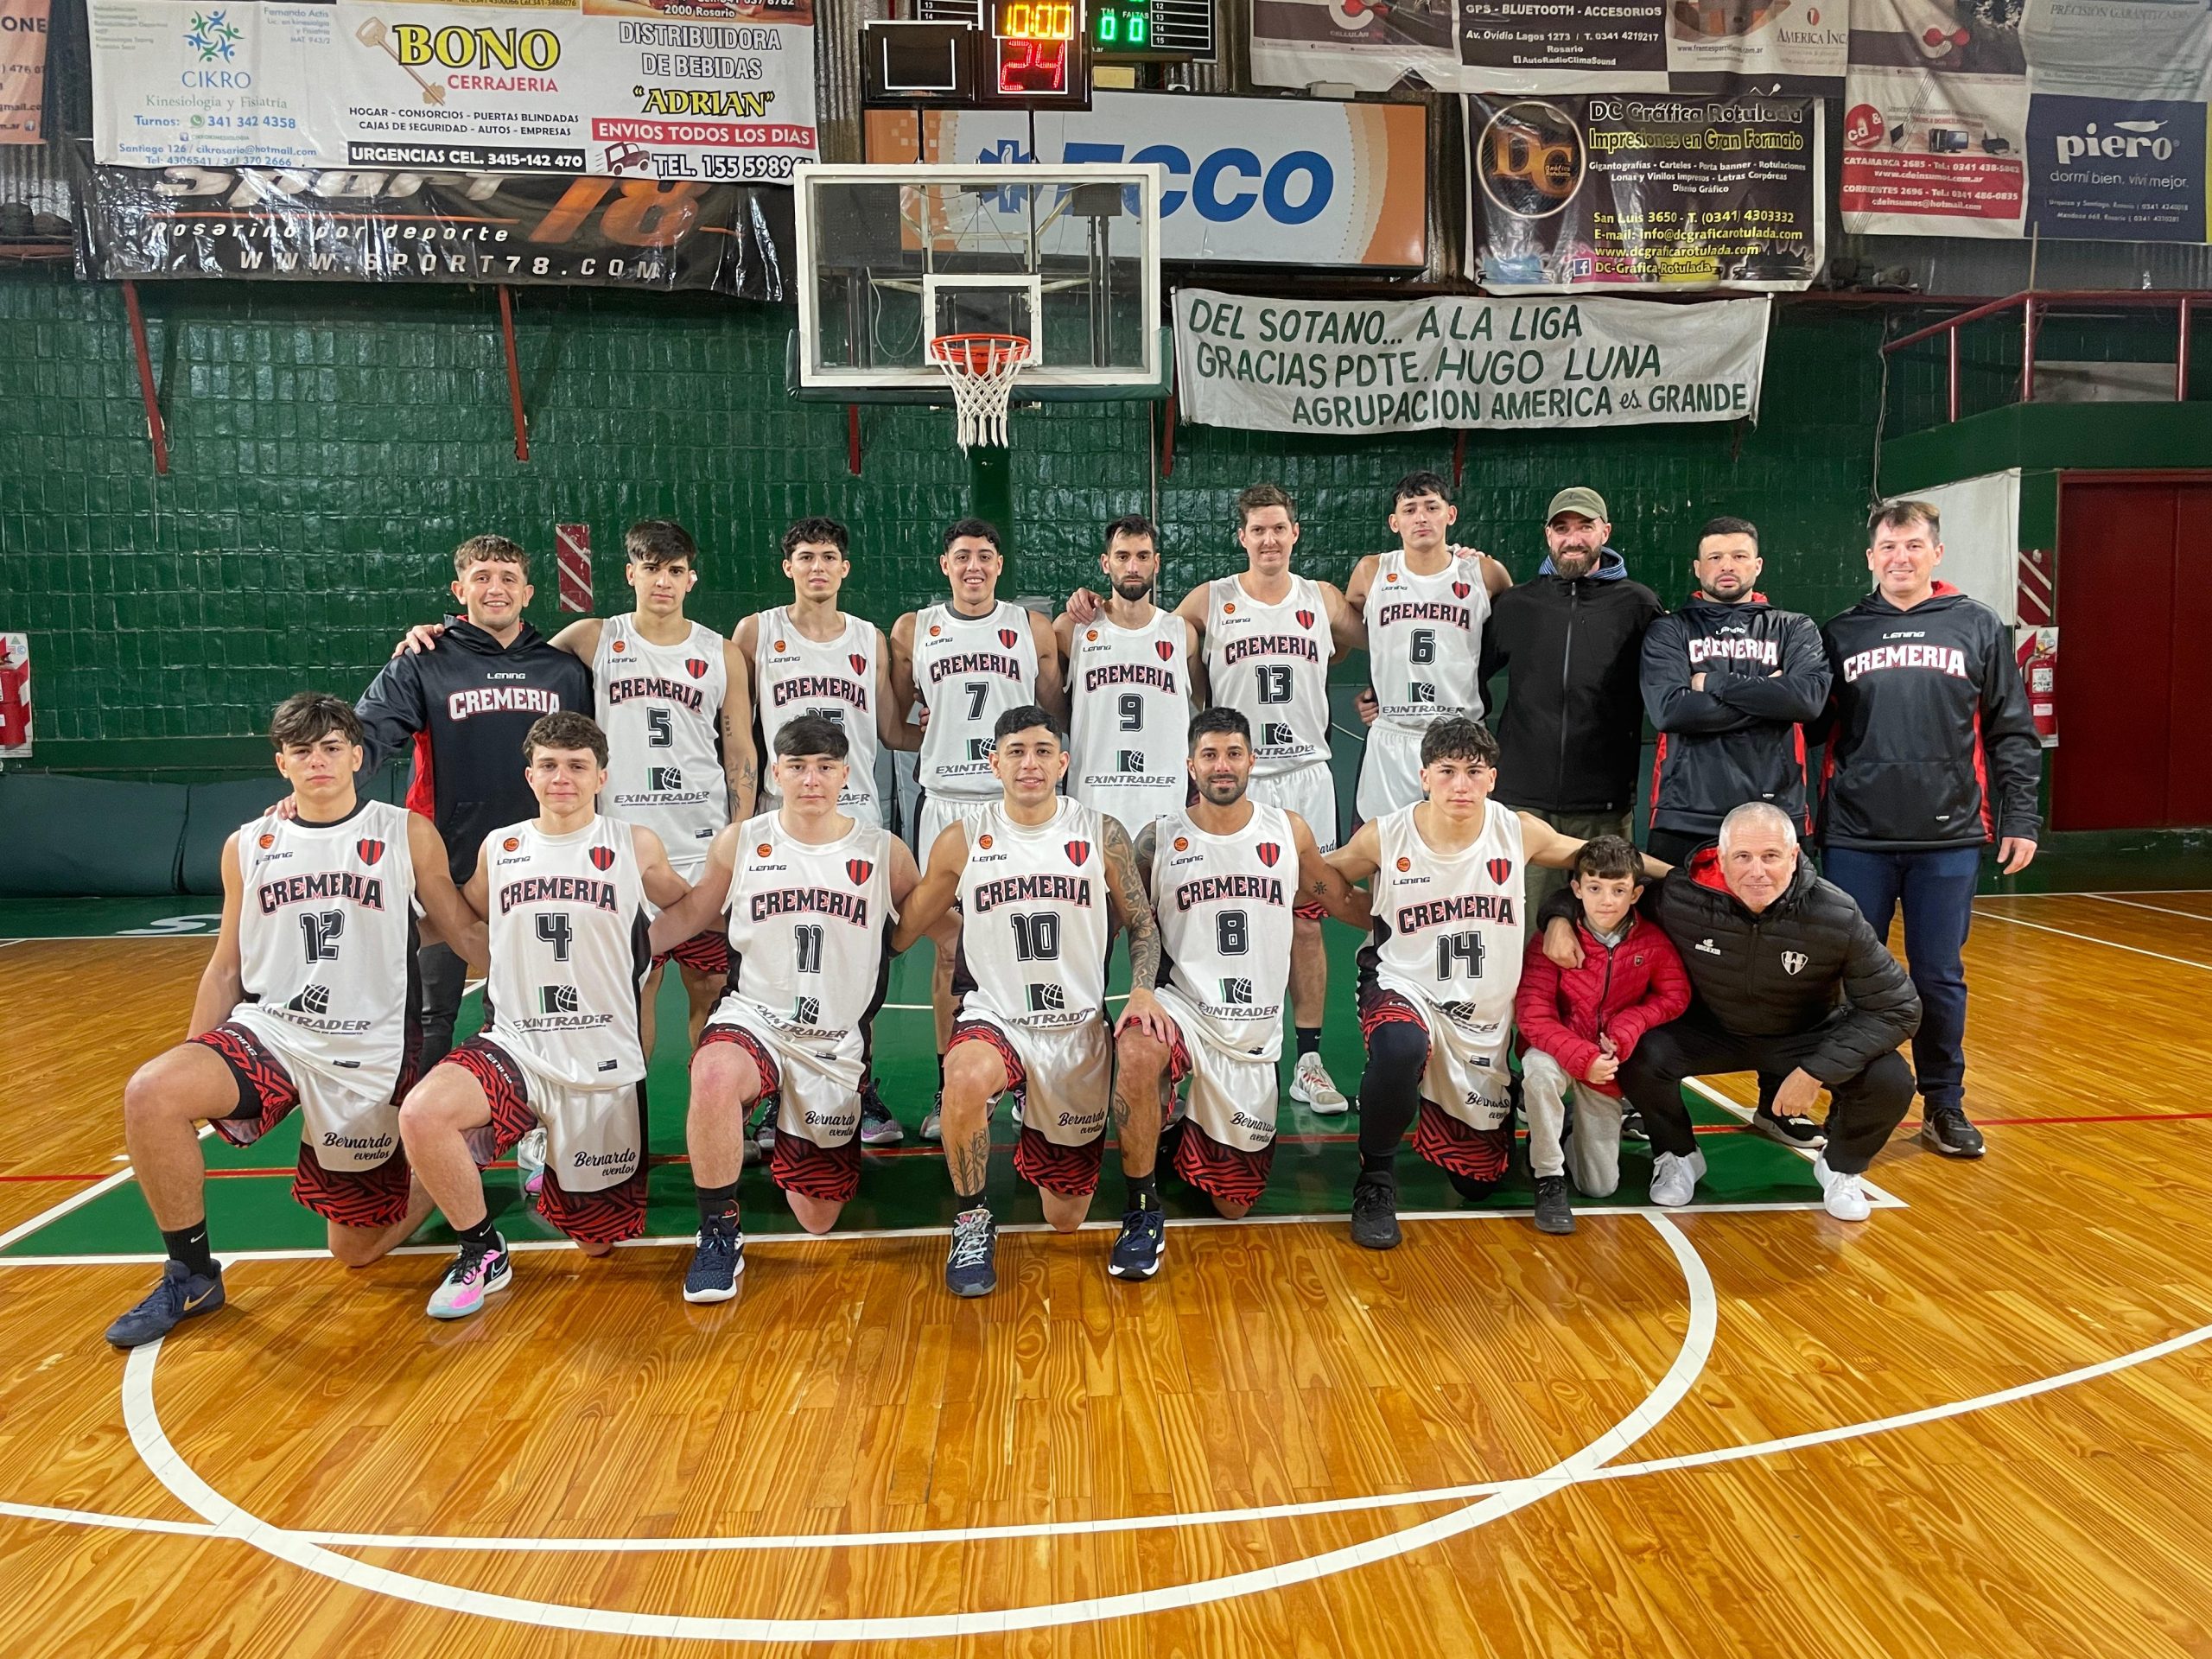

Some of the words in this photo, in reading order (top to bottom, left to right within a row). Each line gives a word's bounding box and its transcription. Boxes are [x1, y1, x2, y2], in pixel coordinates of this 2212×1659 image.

[664, 5, 693, 16] 2000
[696, 7, 734, 18] Rosario
[1007, 4, 1071, 37] 10:00
[1466, 5, 1491, 14] GPS
[1503, 6, 1574, 16] BLUETOOTH
[1584, 6, 1662, 16] ACCESORIOS
[620, 22, 782, 50] DISTRIBUIDORA
[1101, 16, 1115, 41] 0
[1128, 19, 1144, 41] 0
[1466, 30, 1482, 40] Av.
[1484, 31, 1513, 40] Ovidio
[1516, 32, 1544, 41] Lagos
[1548, 32, 1570, 41] 1273
[1621, 32, 1658, 41] 4219217
[392, 24, 561, 71] BONO
[1522, 56, 1616, 66] AutoRadioClimaSound
[642, 53, 671, 76] DE
[675, 55, 762, 79] BEBIDAS
[1001, 40, 1065, 91] 24
[182, 71, 251, 88] CIKRO
[448, 74, 558, 92] CERRAJERIA
[228, 99, 234, 111] y
[349, 107, 388, 117] HOGAR
[398, 109, 463, 119] CONSORCIOS
[474, 112, 518, 121] PUERTAS
[521, 113, 579, 123] BLINDADAS
[1590, 101, 1624, 121] DC
[1627, 102, 1703, 122] Gráfica
[1707, 104, 1802, 123] Rotulada
[134, 116, 180, 125] Turnos:
[208, 117, 230, 127] 341
[237, 117, 258, 127] 342
[263, 117, 295, 128] 4358
[359, 121, 389, 130] CAJAS
[410, 123, 467, 133] SEGURIDAD
[478, 125, 510, 135] AUTOS
[520, 126, 570, 136] EMPRESAS
[599, 123, 664, 140] ENVIOS
[668, 126, 729, 142] TODOS
[734, 129, 766, 143] LOS
[771, 130, 810, 145] DIAS
[119, 143, 164, 154] Santiago
[168, 144, 186, 153] 126
[196, 145, 316, 156] cikrosario@hotmail.com
[1590, 128, 1680, 154] Impresiones
[1683, 135, 1702, 149] en
[1705, 129, 1741, 150] Gran
[1745, 129, 1803, 150] Formato
[2056, 122, 2172, 164] piero
[167, 156, 211, 165] 4306541
[265, 157, 291, 166] 2666
[352, 147, 445, 163] URGENCIAS
[449, 150, 484, 164] CEL.
[487, 152, 551, 166] 3415-142
[555, 155, 582, 168] 470
[652, 154, 697, 179] TEL.
[702, 155, 739, 180] 155
[1589, 162, 1650, 172] Gigantografías
[1720, 162, 1751, 170] banner
[1718, 173, 1745, 181] Letras
[1593, 213, 1613, 223] San
[1618, 213, 1643, 223] Luis
[1648, 212, 1676, 221] 3650
[1702, 209, 1741, 224] (0341)
[1744, 210, 1793, 223] 4303332
[315, 224, 365, 242] por
[384, 225, 508, 243] deporte
[1595, 231, 1635, 240] E-mail:
[1595, 243, 1759, 258] www.dcgraficarotulada.com
[1188, 299, 1245, 339] DEL
[1259, 308, 1402, 346] SOTANO...
[1417, 306, 1440, 341] A
[1450, 308, 1493, 341] LA
[1510, 305, 1582, 340] LIGA
[1196, 342, 1327, 388] GRACIAS
[1336, 350, 1428, 387] PDTE.
[1435, 348, 1543, 384] HUGO
[1564, 345, 1661, 380] LUNA
[1291, 389, 1480, 425] AGRUPACION
[1491, 385, 1611, 421] AMERICA
[1618, 395, 1642, 412] es
[1649, 383, 1745, 413] GRANDE
[1379, 601, 1471, 632] CREMERIA
[1224, 634, 1319, 667] CREMERIA
[1409, 628, 1436, 665] 6
[1689, 637, 1780, 666] CREMERIA
[929, 652, 1021, 684] CREMERIA
[1843, 643, 1968, 684] CREMERIA
[1084, 664, 1179, 695] CREMERIA
[1255, 664, 1294, 704] 13
[448, 687, 561, 720] CREMERIA
[608, 677, 705, 715] CREMERIA
[772, 675, 868, 713] CREMERIA
[964, 681, 988, 721] 7
[1117, 693, 1144, 732] 9
[1382, 707, 1465, 715] EXINTRADER
[647, 707, 673, 747] 5
[1084, 776, 1176, 785] EXINTRADER
[613, 791, 710, 803] EXINTRADER
[257, 872, 386, 915] CREMERIA
[500, 877, 619, 916] CREMERIA
[974, 874, 1093, 913] CREMERIA
[1176, 875, 1285, 912] CREMERIA
[751, 887, 868, 929] CREMERIA
[1397, 894, 1516, 935] CREMERIA
[299, 909, 345, 964] 12
[536, 912, 572, 962] 4
[1010, 911, 1060, 962] 10
[1216, 910, 1249, 957] 8
[795, 925, 823, 973] 11
[1437, 931, 1485, 981] 14
[513, 1014, 614, 1031] EXINTRADER
[321, 1131, 392, 1151] Bernardo
[354, 1147, 390, 1161] eventos
[574, 1148, 637, 1168] Bernardo
[602, 1164, 635, 1177] eventos
